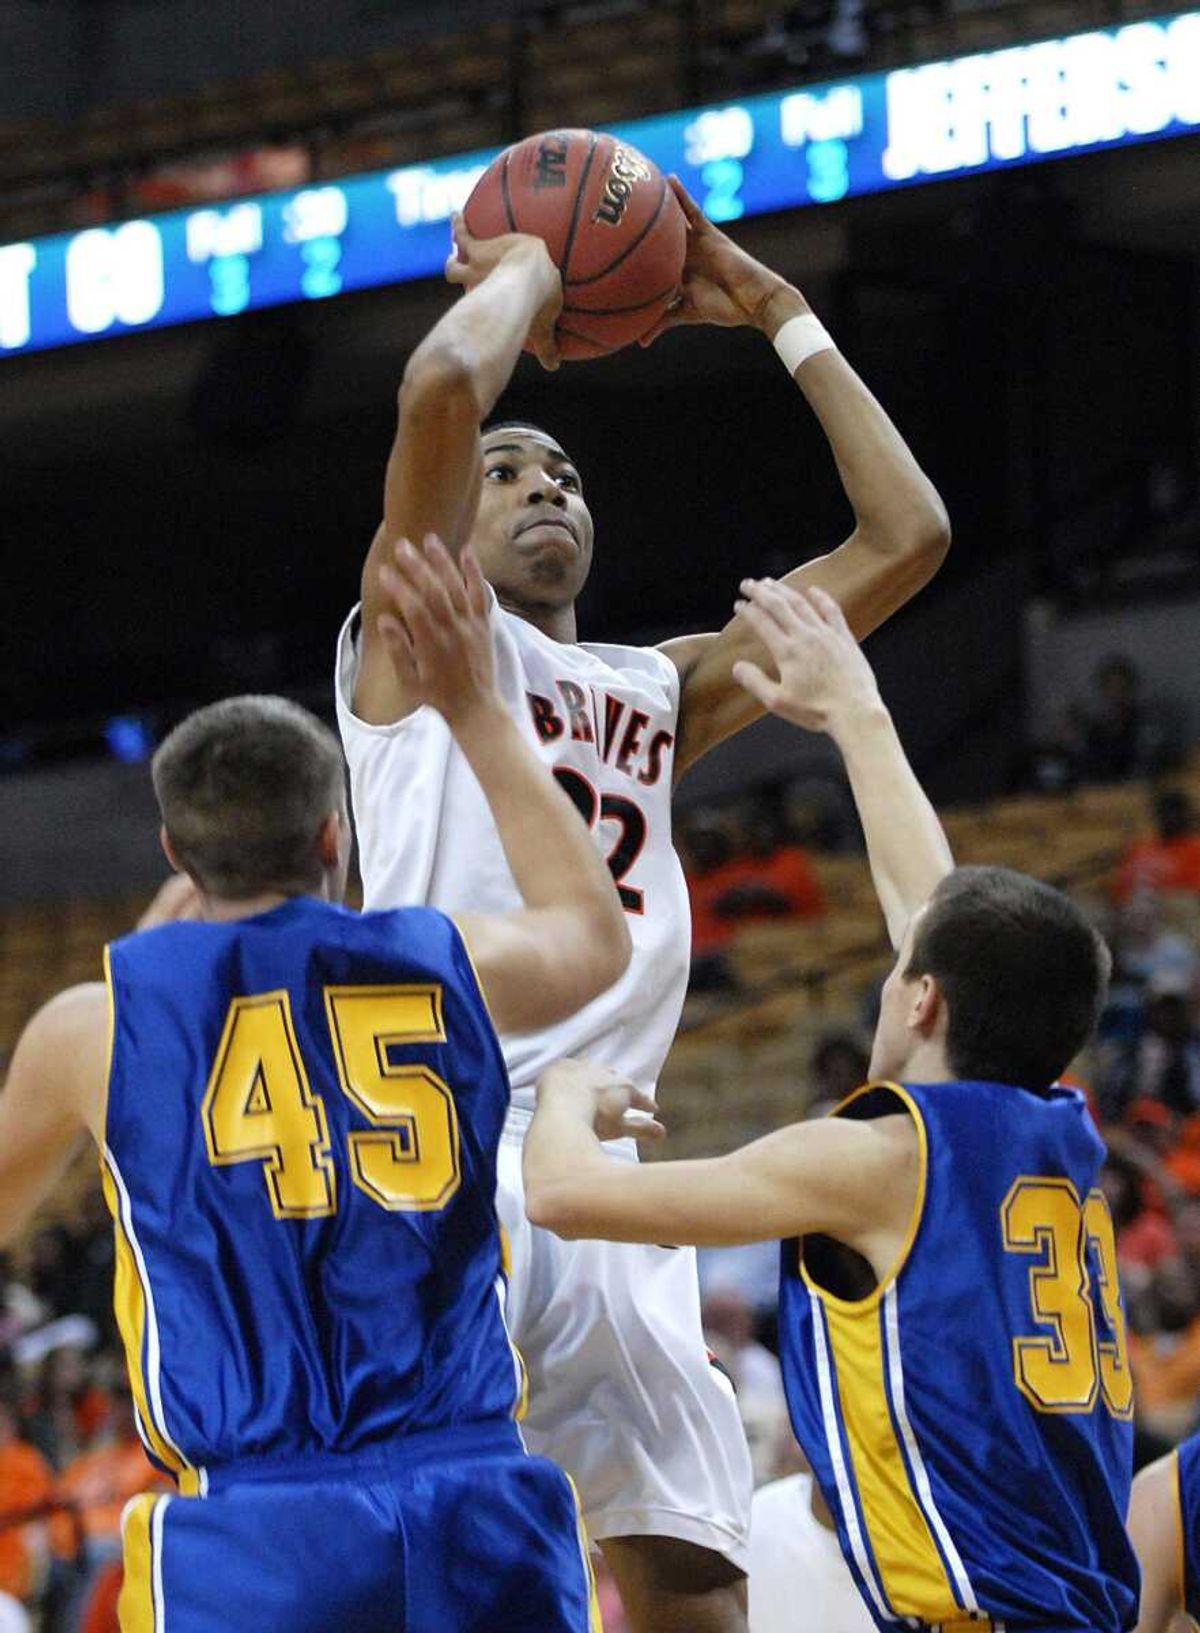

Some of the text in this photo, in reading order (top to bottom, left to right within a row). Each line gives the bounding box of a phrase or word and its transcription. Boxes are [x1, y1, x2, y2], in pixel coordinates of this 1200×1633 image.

[525, 680, 674, 787] BRVES
[200, 982, 462, 1221] 45
[1000, 1173, 1135, 1421] 33
